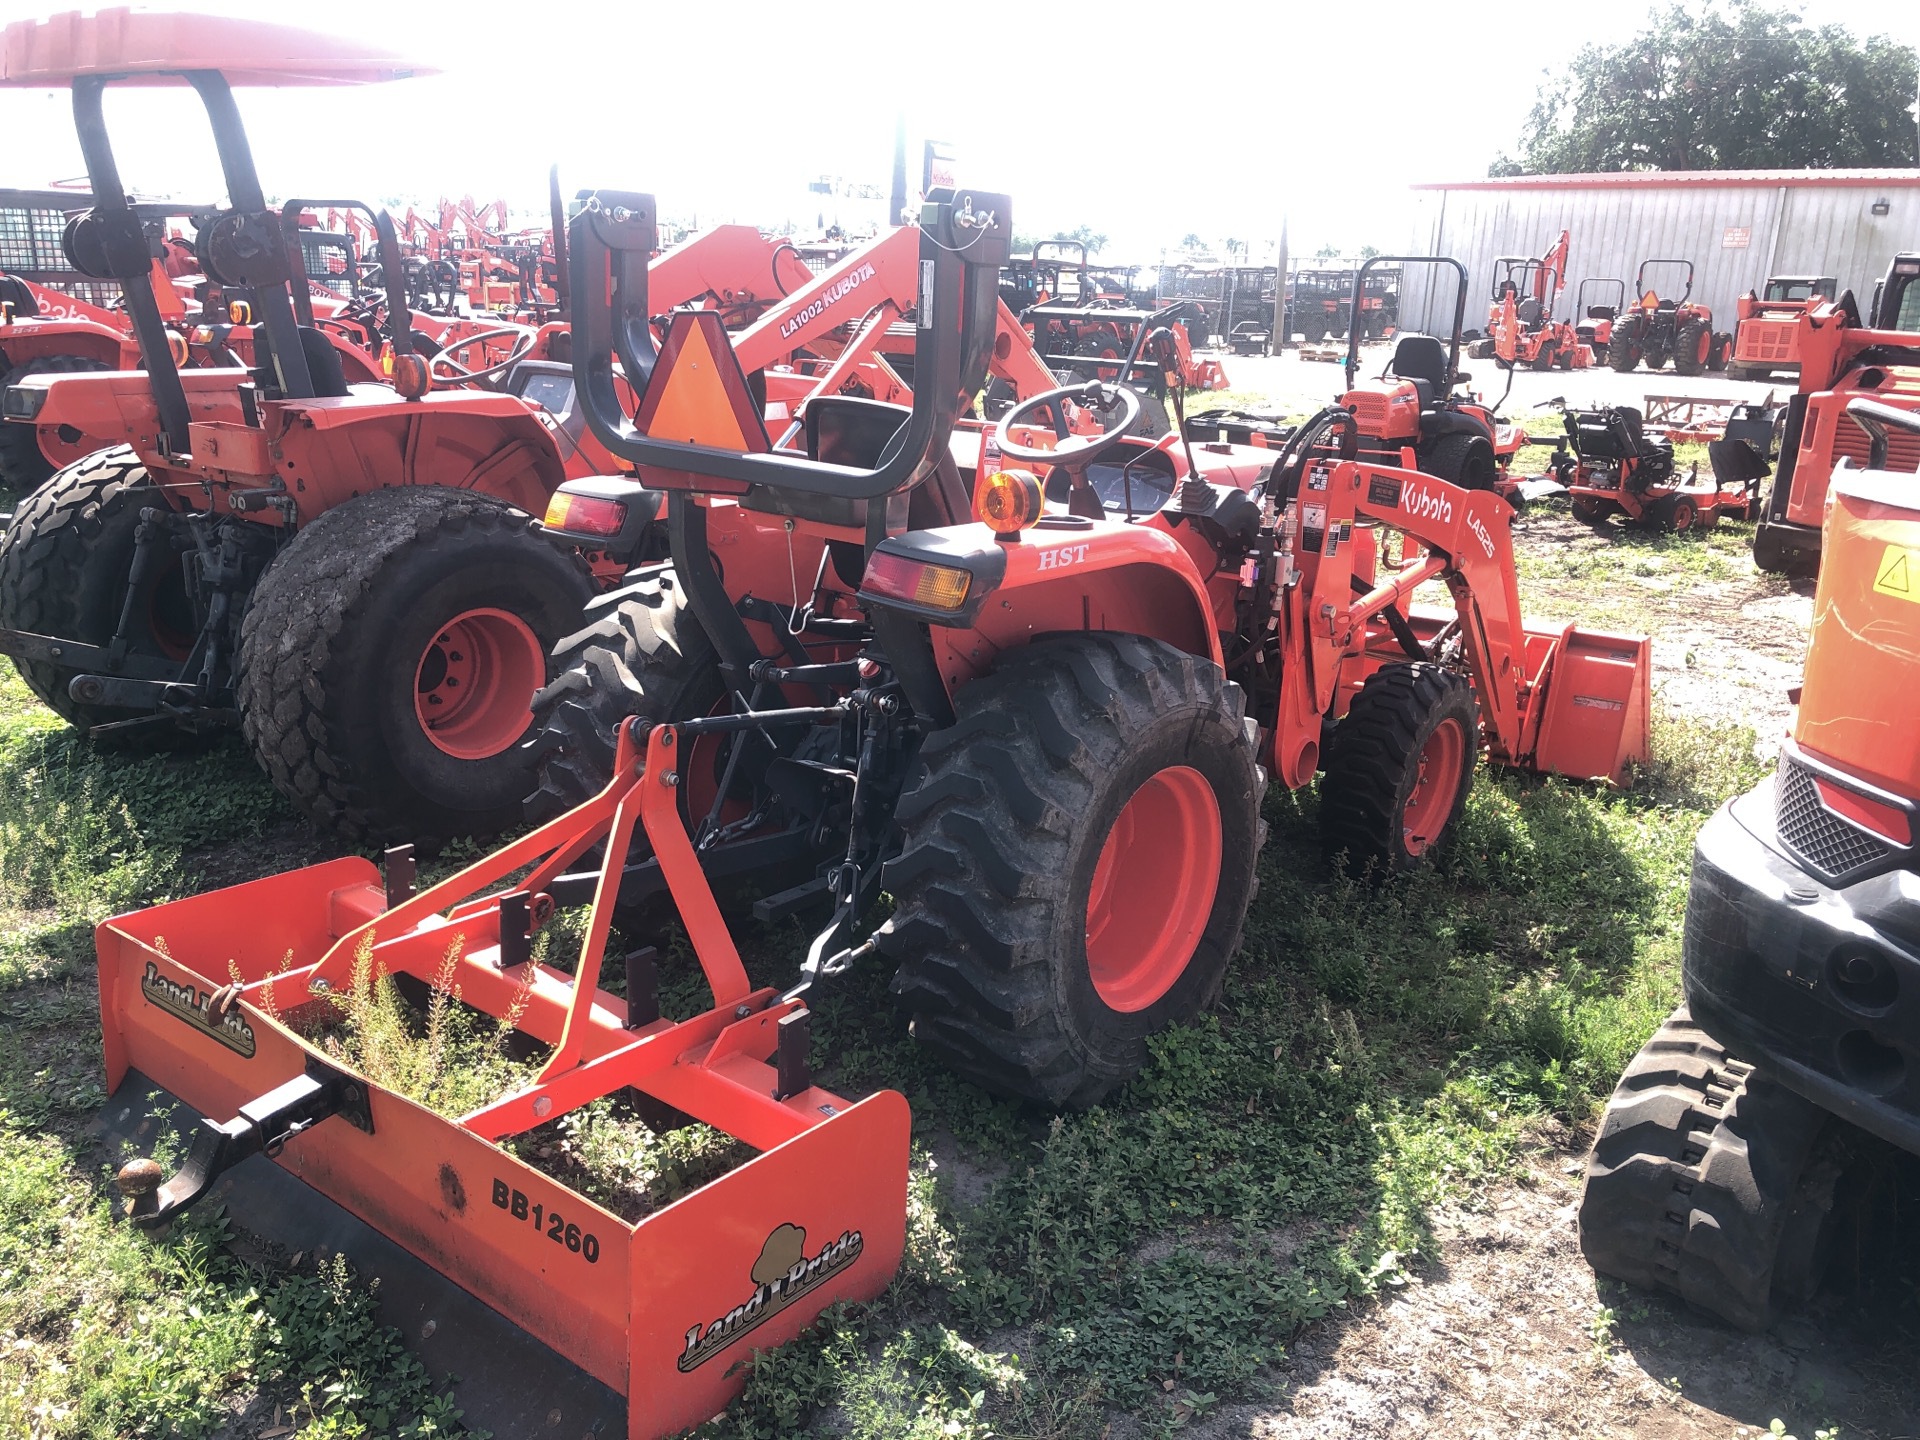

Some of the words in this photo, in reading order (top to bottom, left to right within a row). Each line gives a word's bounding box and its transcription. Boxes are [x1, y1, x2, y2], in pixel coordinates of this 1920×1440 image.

[780, 299, 825, 339] LA1002
[821, 261, 876, 309] KUBOTA
[1400, 480, 1452, 524] Kubota
[1466, 509, 1495, 558] LA525
[1036, 543, 1090, 571] HST
[143, 962, 195, 1012] Land
[200, 990, 254, 1046] Pide
[492, 1177, 600, 1264] BB1260
[682, 1282, 767, 1363] Land
[784, 1230, 862, 1298] Pride
